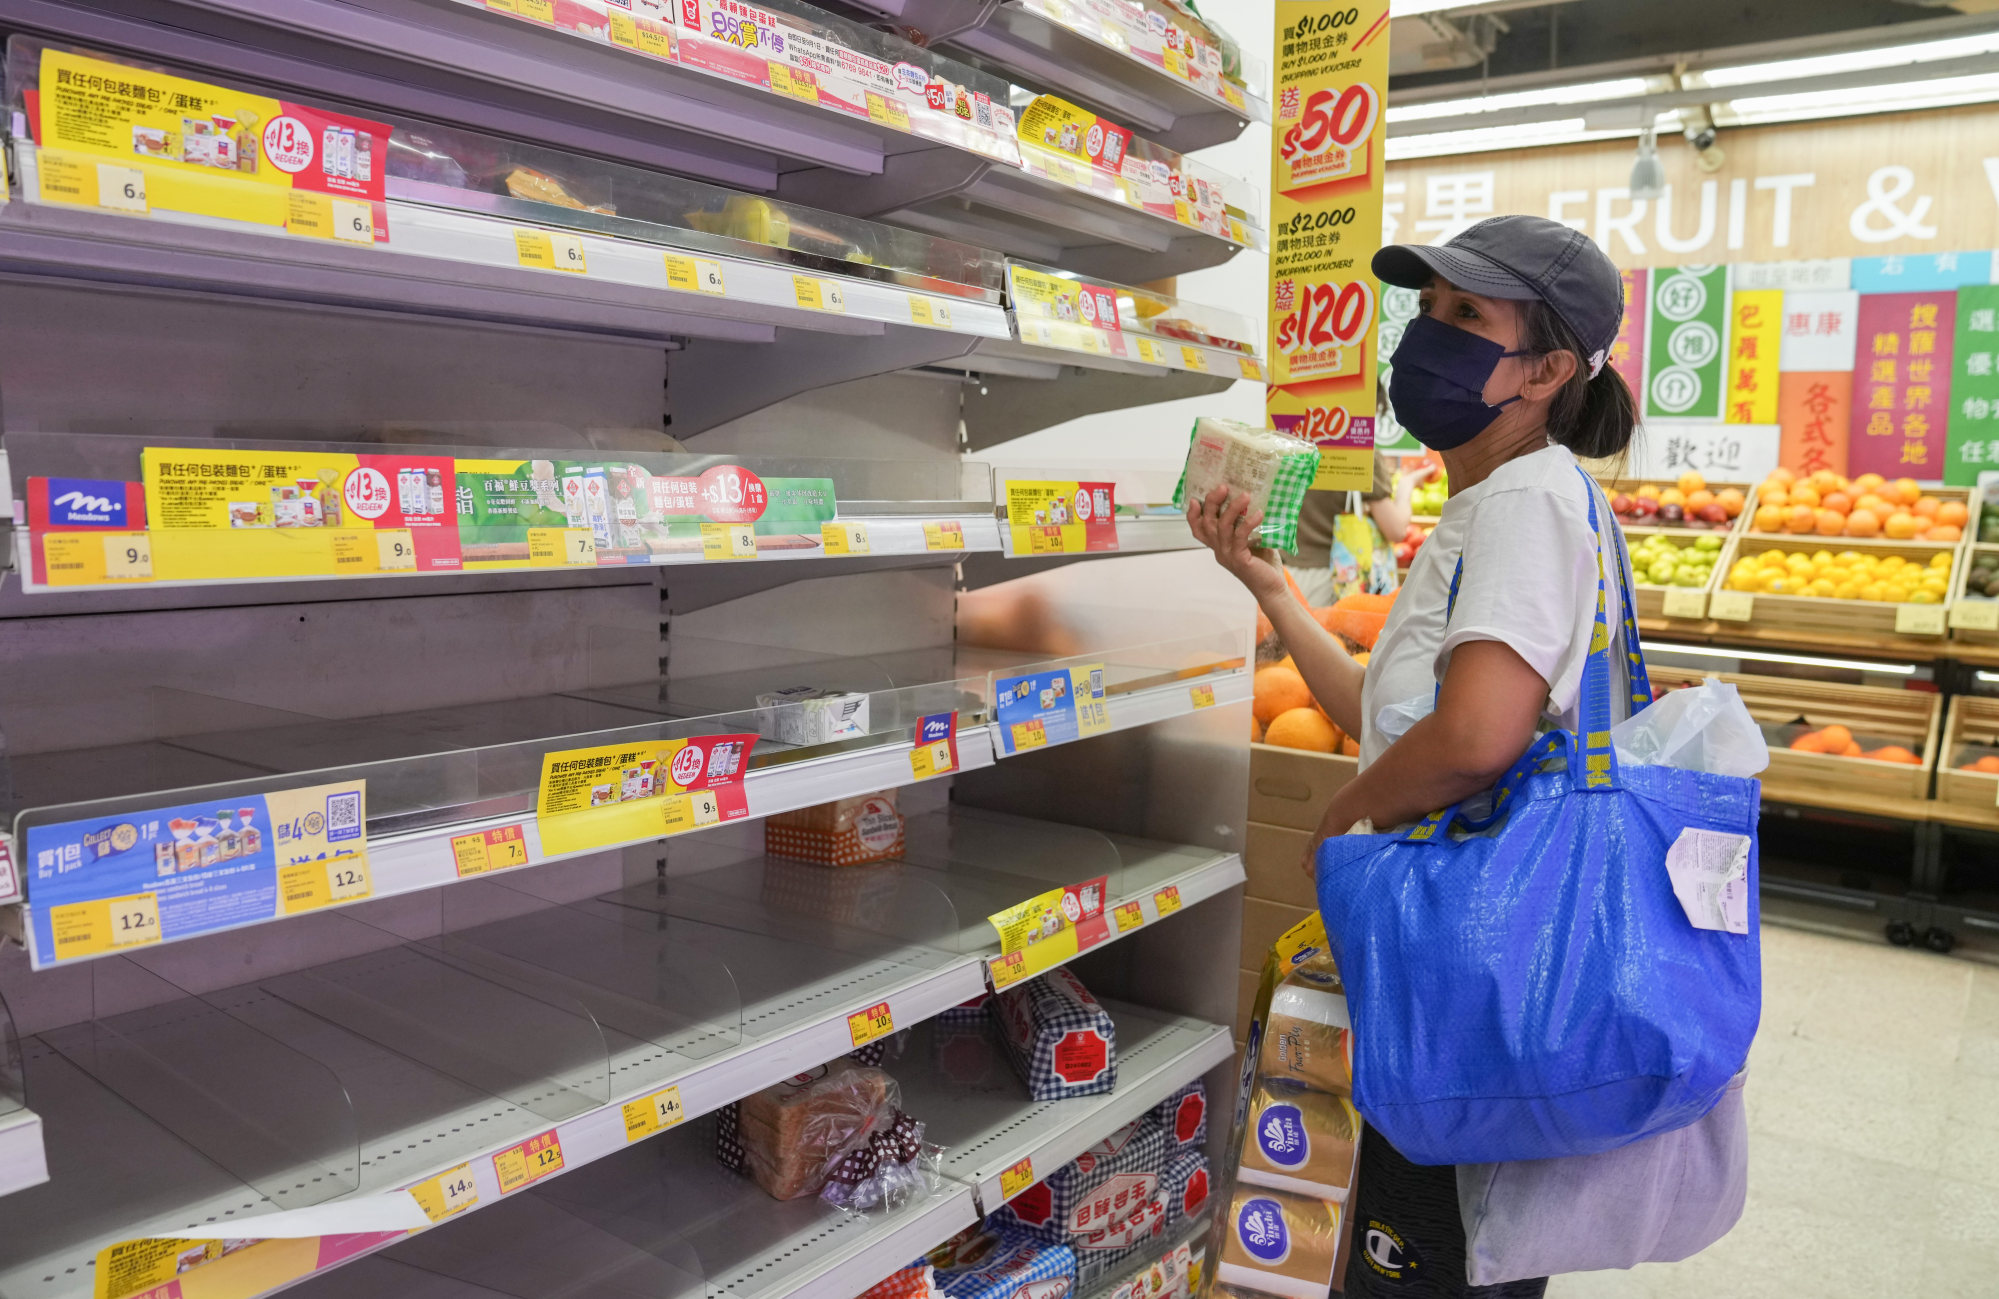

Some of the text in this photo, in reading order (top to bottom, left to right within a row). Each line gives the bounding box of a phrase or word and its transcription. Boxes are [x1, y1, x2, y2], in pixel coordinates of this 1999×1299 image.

[1282, 32, 1348, 57] 購物現金券
[1281, 50, 1338, 71] BUY $1,000 IN
[1281, 58, 1362, 84] SHOPPING VOUCHERS
[1280, 86, 1300, 108] 送
[1280, 84, 1374, 160] $50
[1291, 149, 1346, 170] 購物現金券
[124, 183, 146, 200] 6.0
[1548, 173, 1816, 254] FRUIT
[1849, 165, 1938, 243] &
[353, 217, 371, 233] 6.0
[1276, 231, 1341, 253] 購物現金券
[567, 247, 583, 262] 6.0
[1276, 248, 1333, 266] BUY $2,000 IN
[1275, 258, 1354, 279] SHOPPING VOUCHERS
[709, 273, 722, 286] 6.0
[1275, 279, 1294, 300] 送
[1274, 300, 1293, 312] FREE
[1277, 281, 1369, 350] $120
[1786, 311, 1843, 337] 惠康
[1289, 350, 1337, 366] 購物現金券
[1733, 304, 1764, 424] 包羅萬有
[1900, 302, 1939, 465] 搜羅世界各地
[1663, 435, 1741, 471] 歡迎
[652, 481, 698, 495] 買任何包裝
[654, 495, 695, 510] 麵包/蛋糕
[67, 512, 111, 522] Meadows
[393, 542, 412, 557] 9.0
[578, 539, 593, 553] 7.5
[742, 535, 754, 547] 8.5
[126, 547, 149, 564] 9.0
[703, 802, 716, 814] 9.5
[492, 826, 516, 843] 特價
[508, 845, 522, 858] 7.0
[335, 870, 364, 887] 12.0
[122, 912, 155, 930] 12.0
[660, 1101, 680, 1116] 14.0
[529, 1134, 552, 1153] 特價
[1284, 1117, 1296, 1152] Vinda
[537, 1149, 561, 1167] 12.5
[449, 1179, 473, 1198] 14.0
[1264, 1210, 1277, 1247] Vinda
